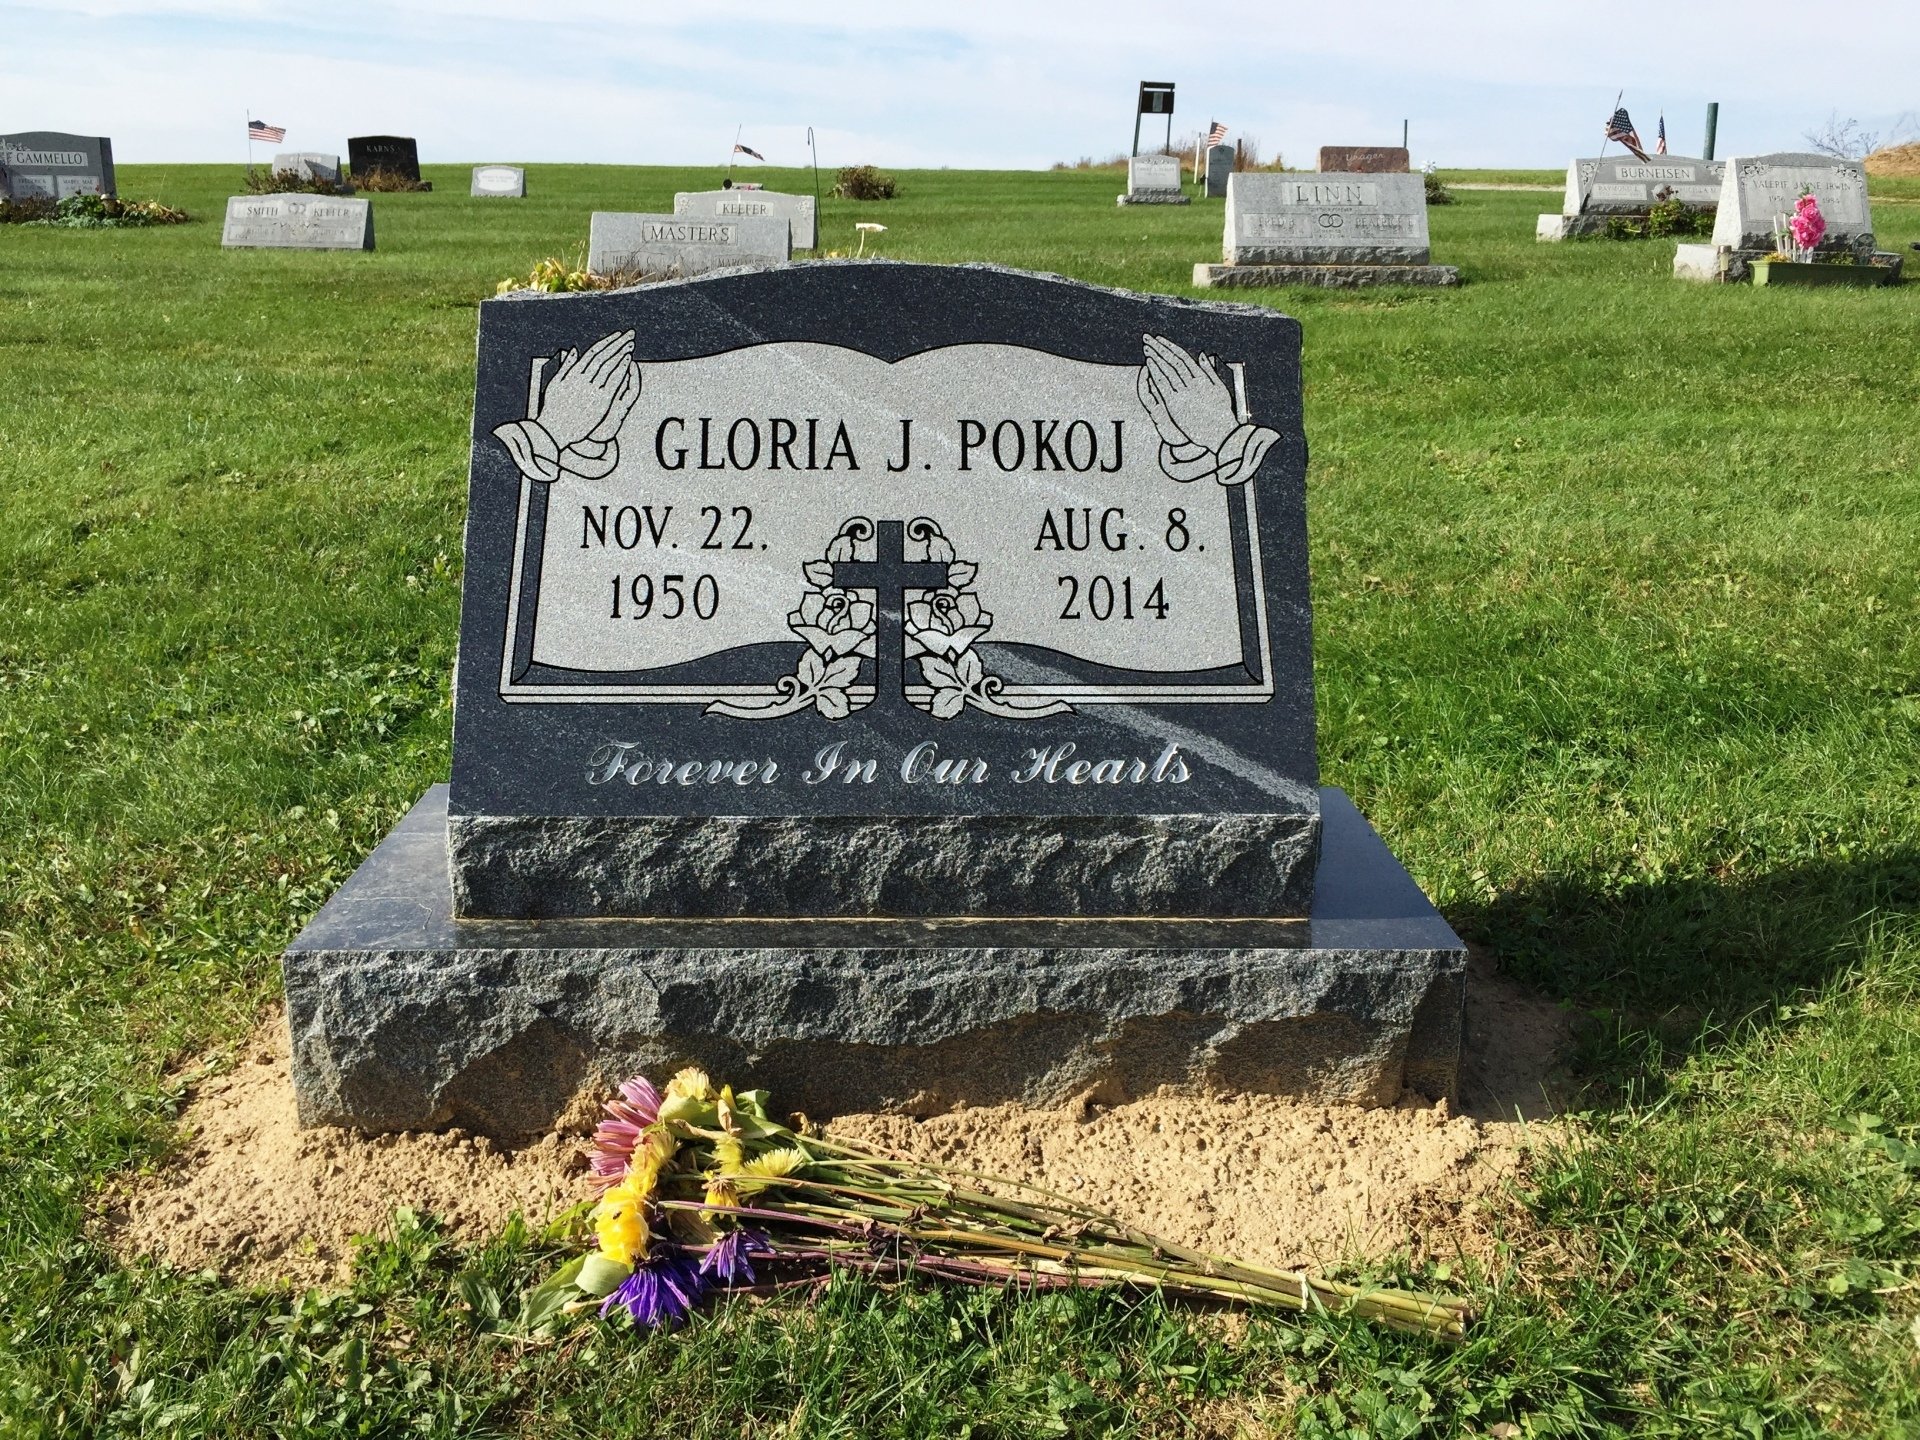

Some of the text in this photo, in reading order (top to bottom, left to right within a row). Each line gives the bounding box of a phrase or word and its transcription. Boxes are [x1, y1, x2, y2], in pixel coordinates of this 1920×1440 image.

[16, 152, 83, 165] GAMMELLO
[1621, 167, 1690, 179] BURNEISEN
[722, 203, 769, 215] KEEFER
[1296, 186, 1362, 203] LINN
[247, 206, 279, 216] SMITH
[650, 225, 731, 242] MASTERS
[655, 416, 1126, 474] GLORIA J. POKOJ
[580, 505, 768, 551] NOV. 22,
[1034, 508, 1144, 552] AUG.
[610, 574, 720, 621] 1950
[1058, 575, 1170, 621] 2014
[585, 739, 1193, 787] Forever In Our Hearts
